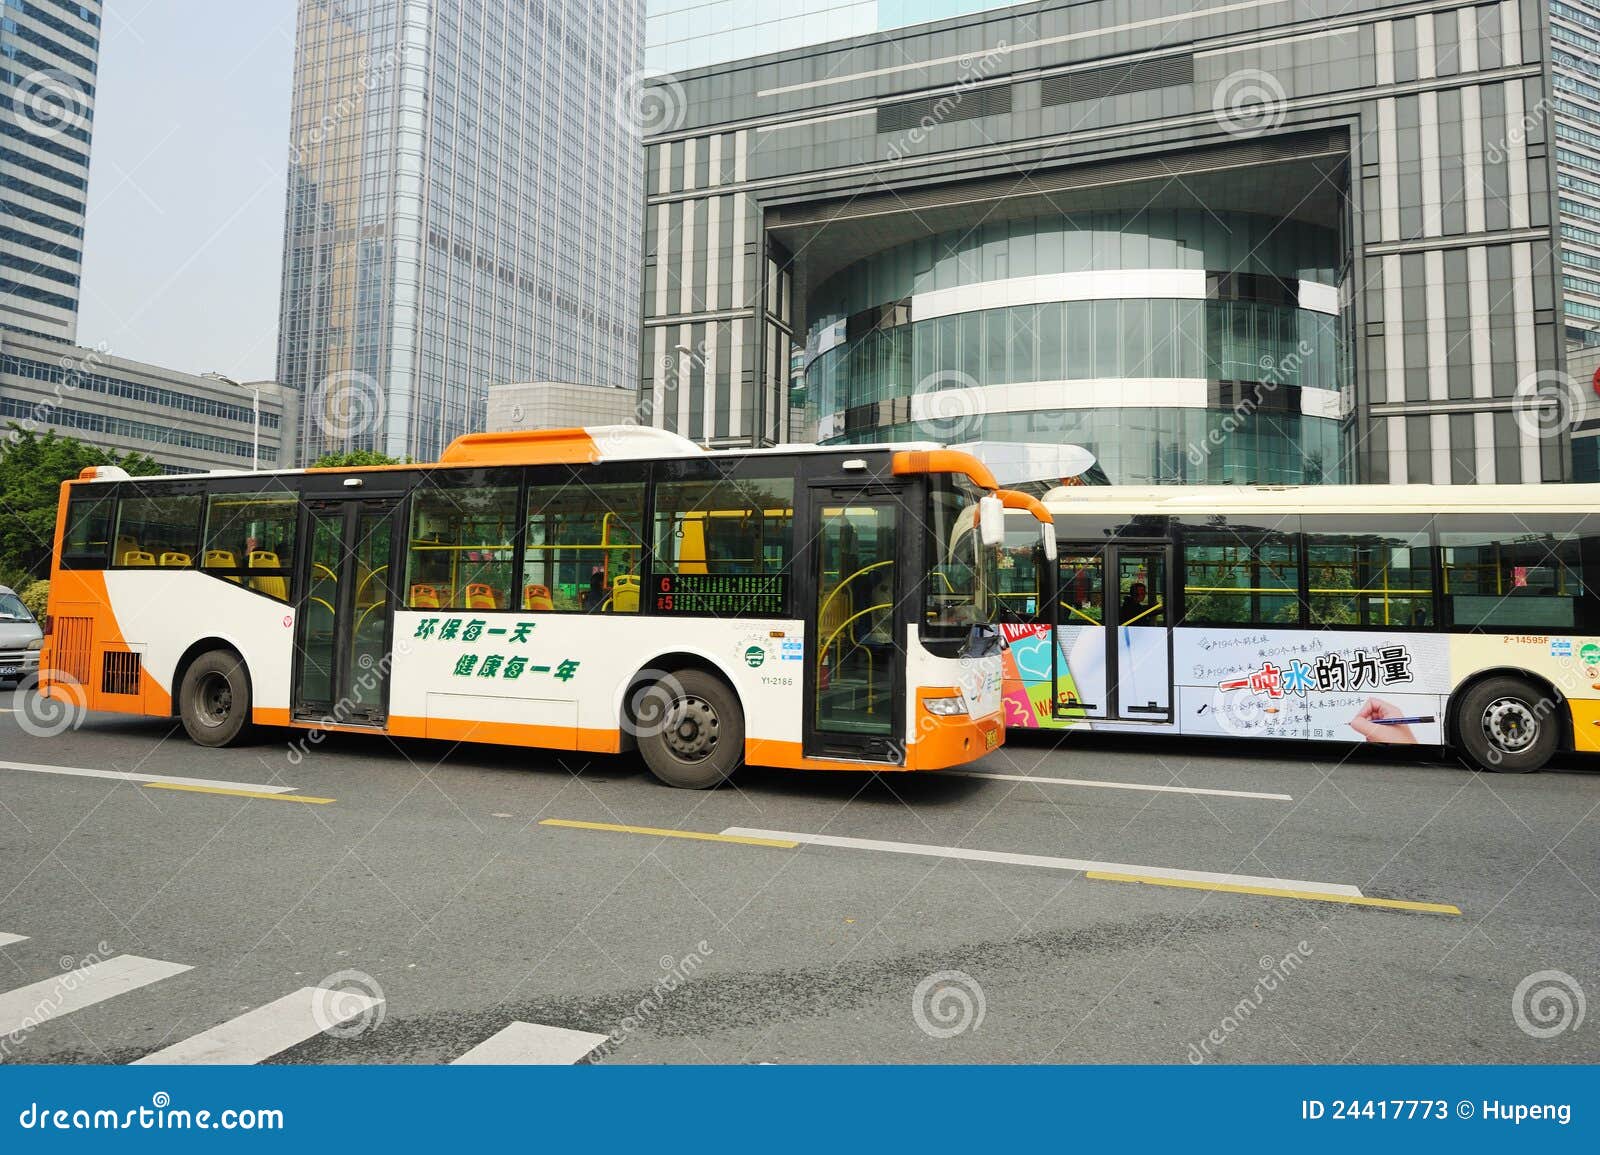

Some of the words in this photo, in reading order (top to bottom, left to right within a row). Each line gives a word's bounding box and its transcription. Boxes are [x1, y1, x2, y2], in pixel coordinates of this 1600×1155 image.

[661, 577, 671, 592] 6
[413, 618, 536, 643] 环保每一天
[1503, 635, 1549, 644] 2-14595F
[453, 653, 581, 682] 健康每一年
[1219, 646, 1413, 698] 一吨水的力量
